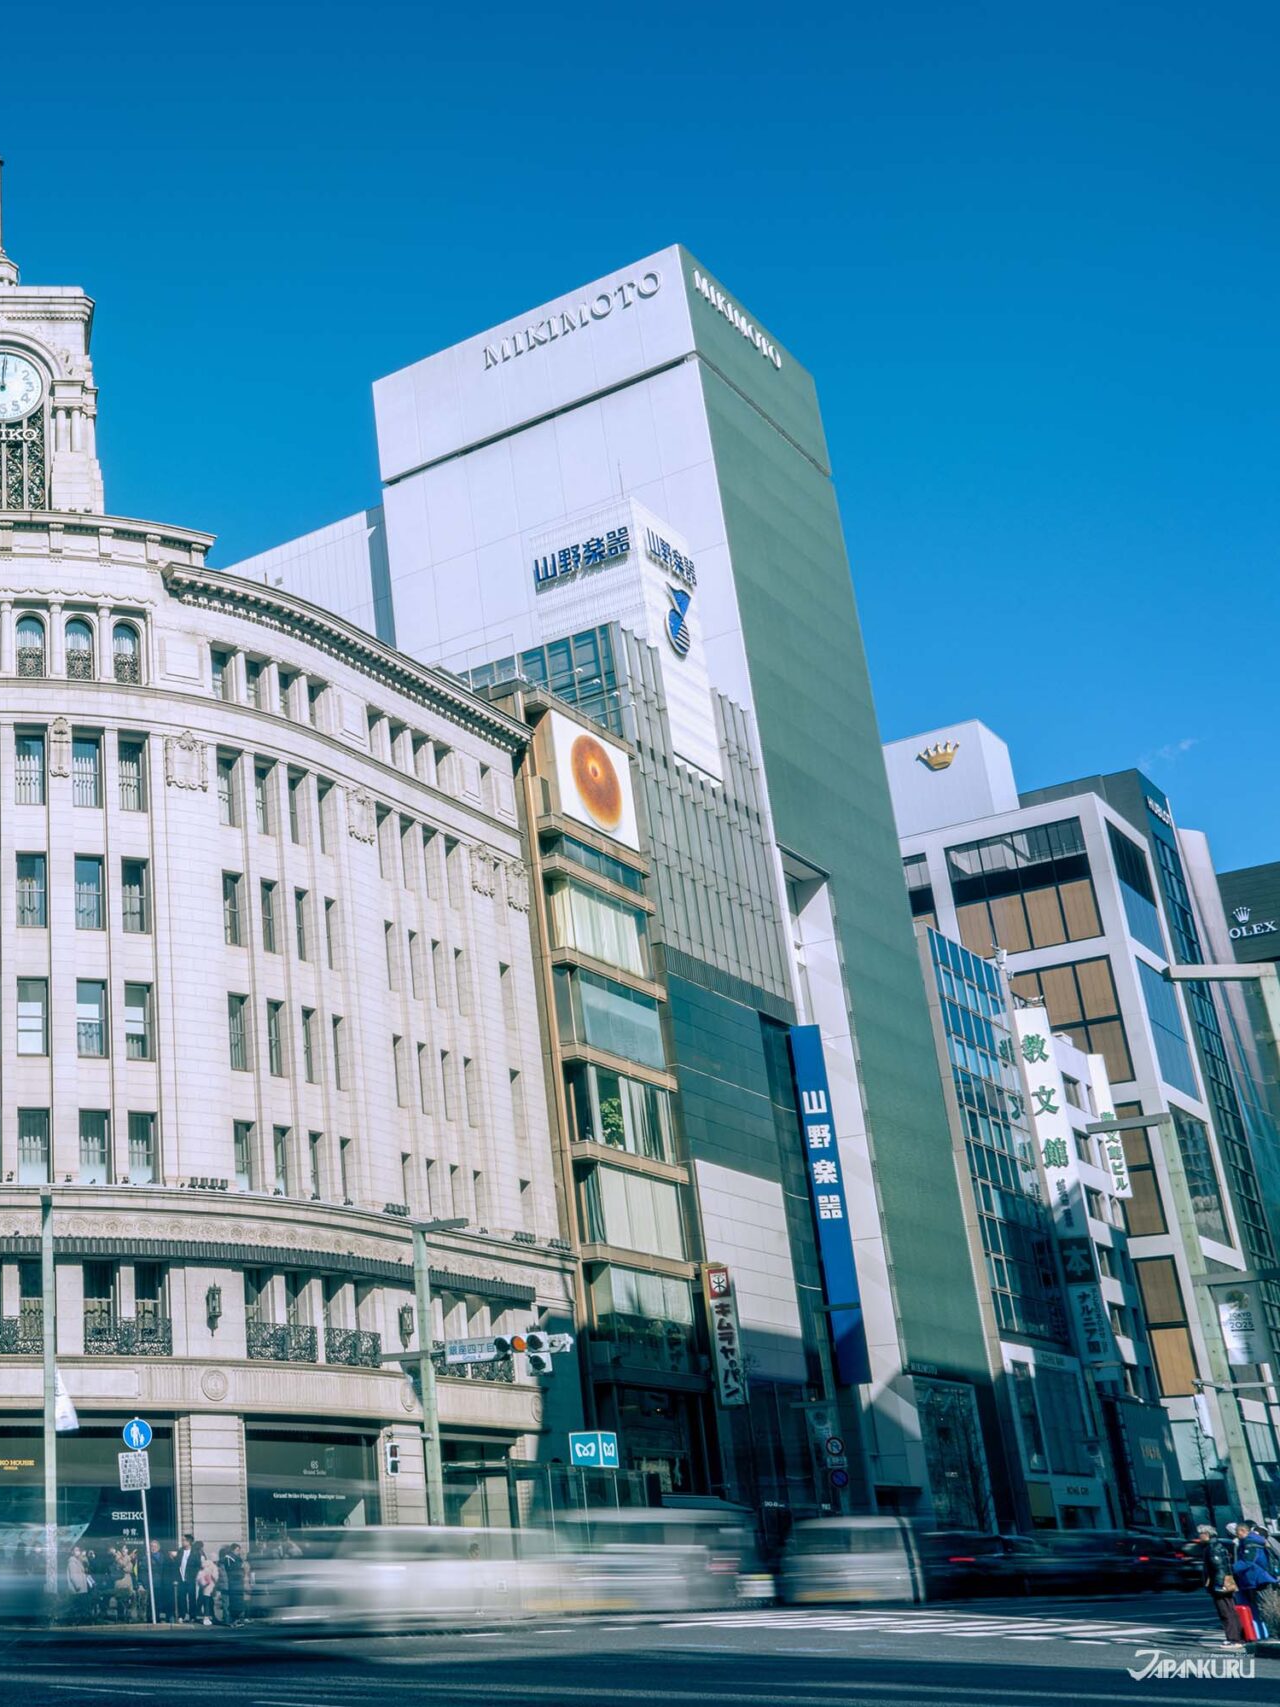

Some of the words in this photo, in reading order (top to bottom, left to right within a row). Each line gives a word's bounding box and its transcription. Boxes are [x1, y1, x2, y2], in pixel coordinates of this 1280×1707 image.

[482, 270, 664, 370] MIKIMOTO
[693, 269, 782, 370] MIKIMOTO
[22, 370, 29, 381] 2
[25, 381, 34, 392] 3
[11, 400, 20, 411] 5
[21, 393, 31, 403] 4
[534, 526, 631, 583] 山野楽器
[646, 526, 697, 587] 山野楽器
[1228, 920, 1278, 940] OLEX
[1021, 1033, 1070, 1169] 教文館
[802, 1089, 843, 1220] 山野楽器
[1063, 1245, 1091, 1277] 本
[1077, 1291, 1102, 1354] ナルニア国
[1229, 1321, 1254, 1329] 2025
[448, 1343, 495, 1355] 銀座四丁目
[714, 1302, 741, 1399] キムラヤのパン
[111, 1511, 145, 1520] SEIKO
